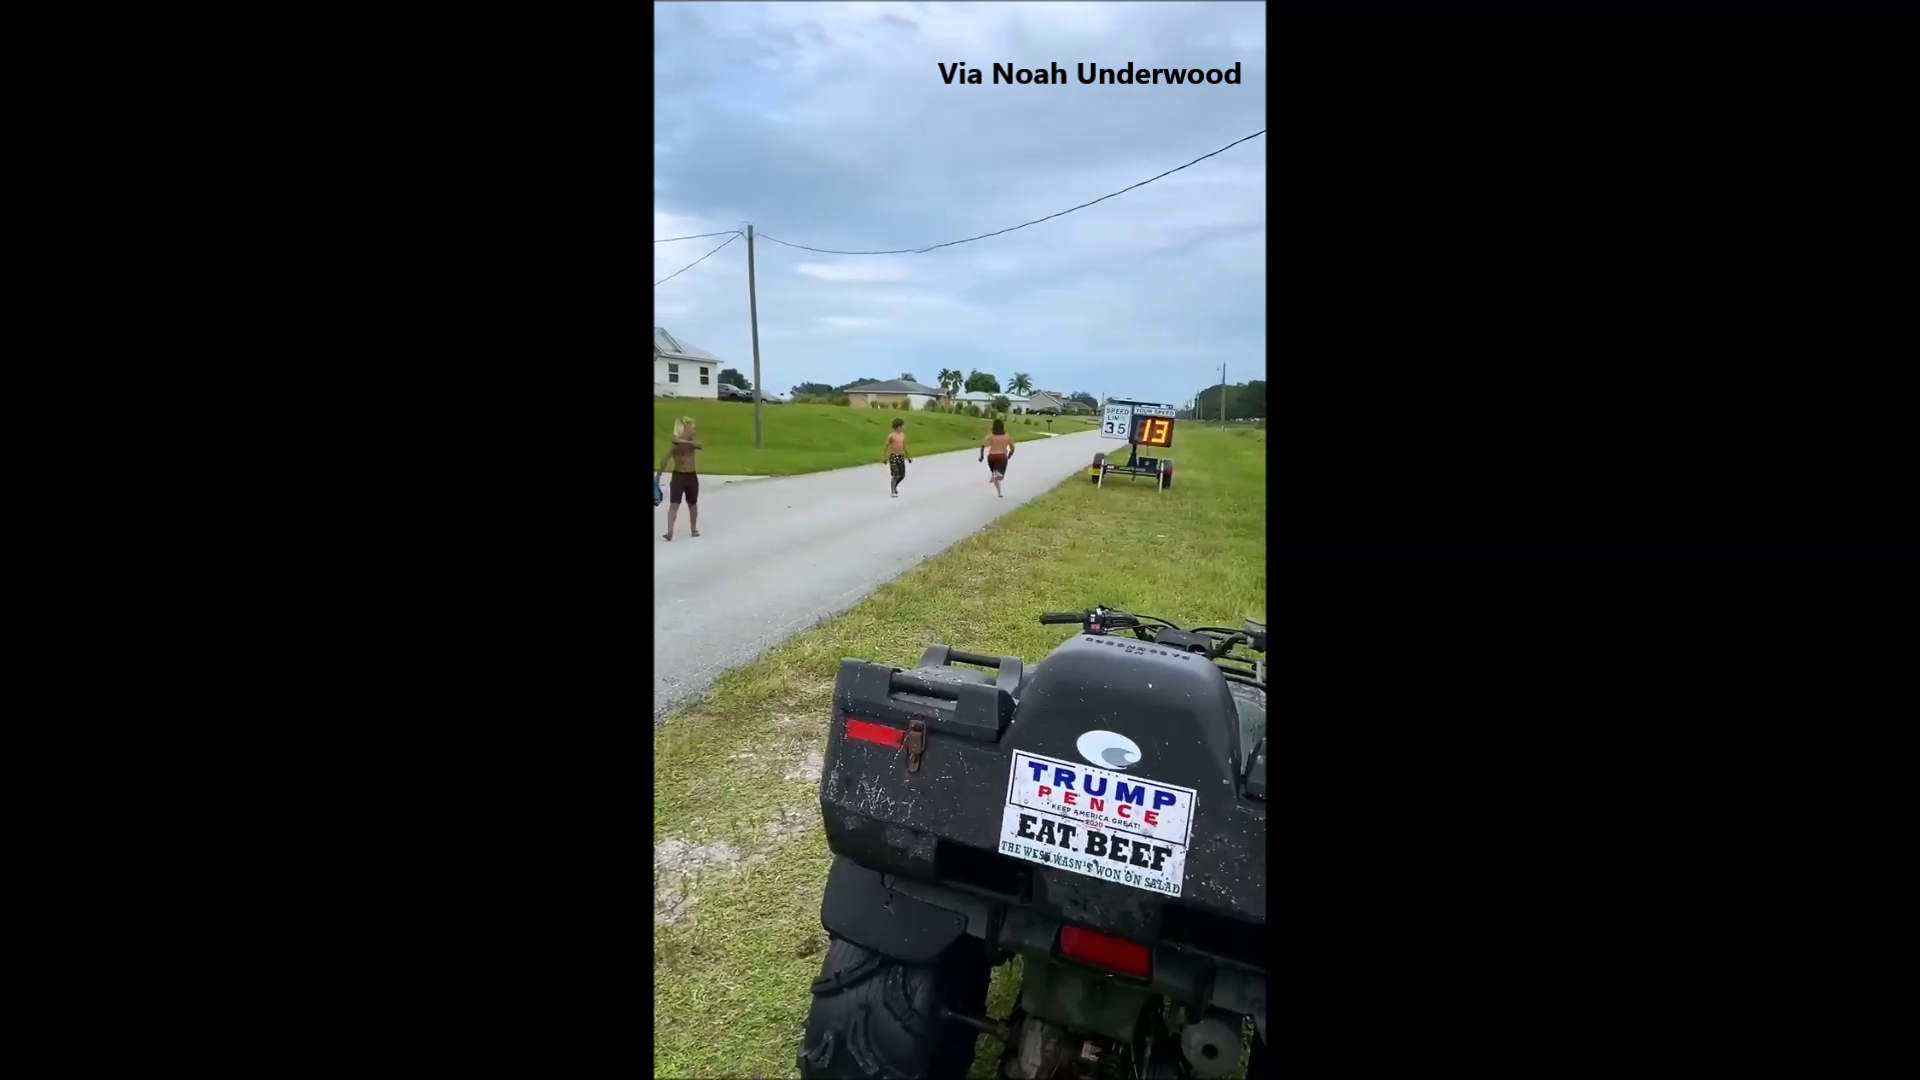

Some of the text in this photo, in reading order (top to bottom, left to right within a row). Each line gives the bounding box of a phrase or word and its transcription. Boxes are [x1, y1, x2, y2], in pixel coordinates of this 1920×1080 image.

[1106, 407, 1130, 416] SPEED
[1104, 421, 1126, 434] 35
[1142, 419, 1169, 443] 13
[1028, 761, 1177, 810] TRUMP
[1038, 785, 1159, 827] PENCE
[1051, 803, 1141, 829] KEEP AMERICA GREAT!
[1085, 819, 1104, 828] 2020
[1017, 813, 1172, 871] EAT BEEF
[1001, 840, 1022, 854] THE
[1096, 865, 1122, 880] WON
[1124, 871, 1143, 886] ON
[1144, 877, 1181, 894] SALAD
